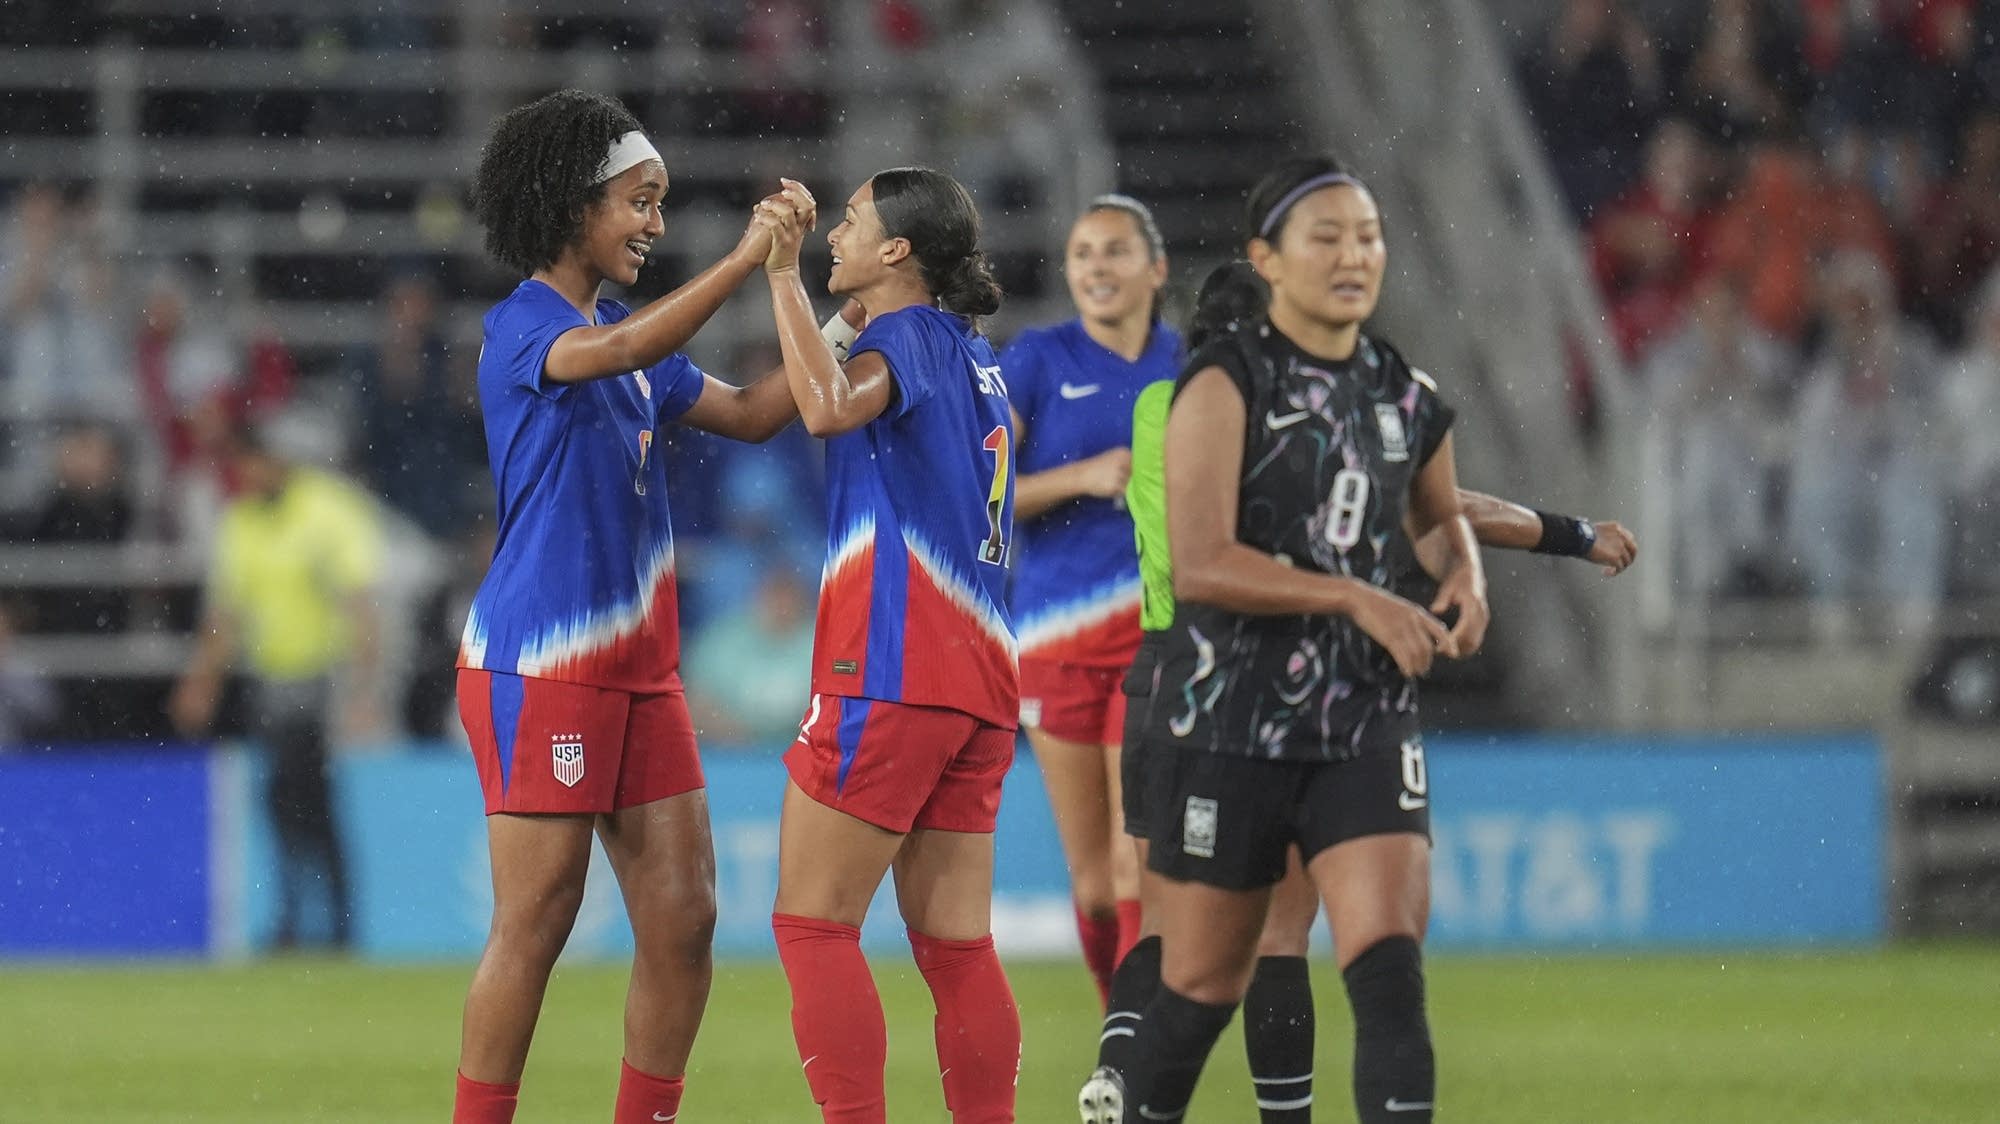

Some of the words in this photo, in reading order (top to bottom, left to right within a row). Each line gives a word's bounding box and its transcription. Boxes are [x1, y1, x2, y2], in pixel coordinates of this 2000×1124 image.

[978, 425, 1010, 569] 1
[1325, 468, 1370, 548] 8
[554, 745, 582, 762] USA
